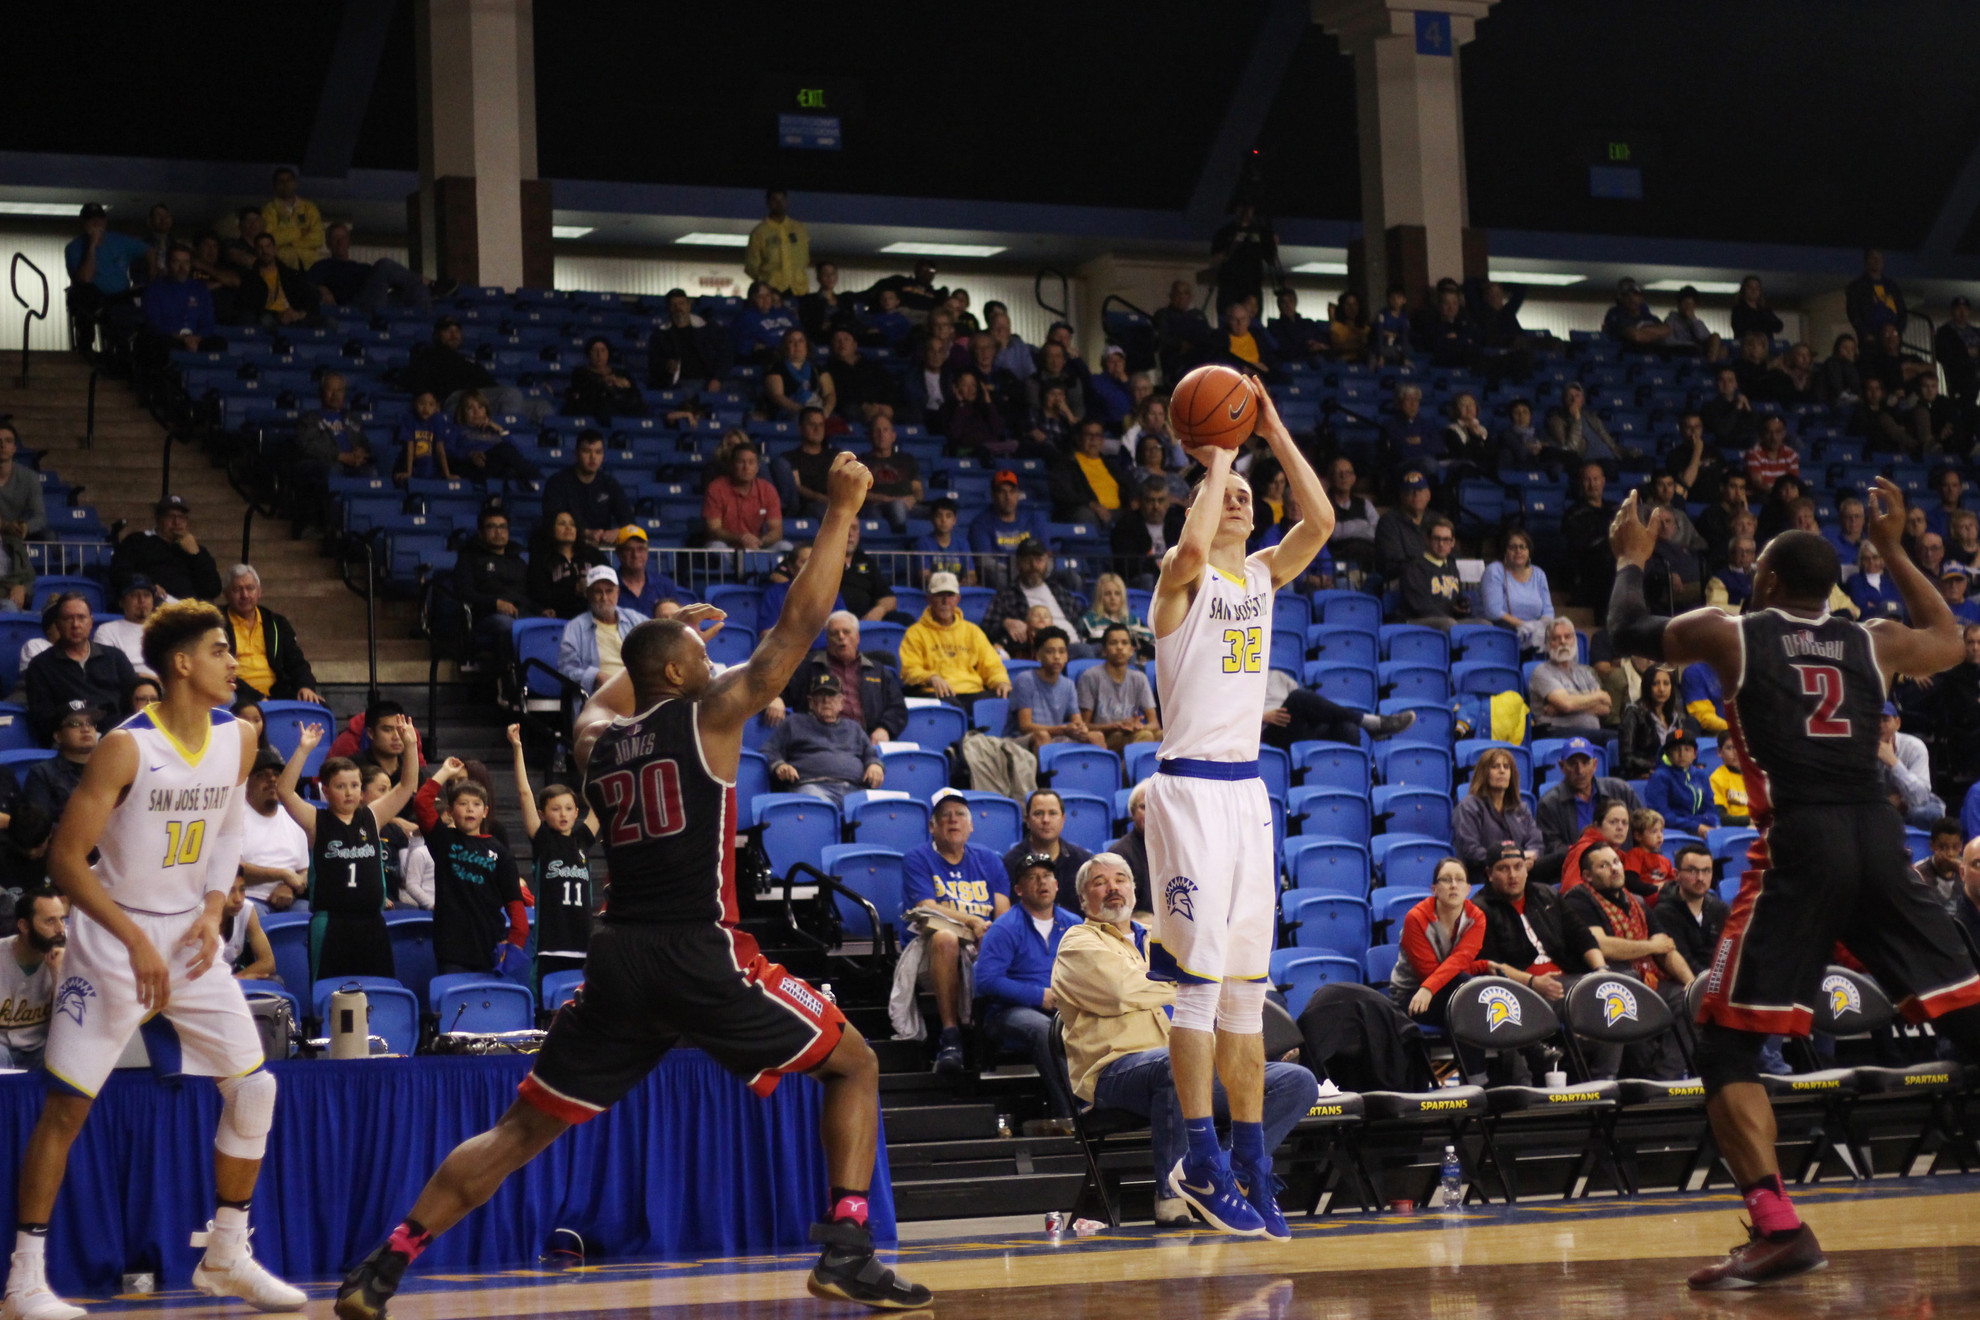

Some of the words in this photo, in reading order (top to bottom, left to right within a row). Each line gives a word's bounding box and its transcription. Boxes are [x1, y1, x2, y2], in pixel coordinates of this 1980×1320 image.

[1424, 20, 1443, 48] 4
[1209, 597, 1231, 621] SAN
[1222, 626, 1262, 674] 32
[1789, 663, 1852, 737] 2
[615, 733, 656, 766] JONES
[148, 789, 173, 811] SAN
[174, 783, 201, 811] JOSÉ
[590, 759, 687, 847] 20
[162, 819, 206, 869] 10
[324, 840, 376, 859] Saints
[347, 863, 357, 888] 1
[562, 881, 583, 907] 11
[1668, 1086, 1706, 1097] SPARTA
[1792, 1080, 1840, 1090] SPARTANS
[1904, 1074, 1949, 1086] SPARTANS
[1420, 1099, 1468, 1111] SPARTANS
[1549, 1092, 1600, 1103] SPARTANS
[1307, 1105, 1342, 1116] RTANS
